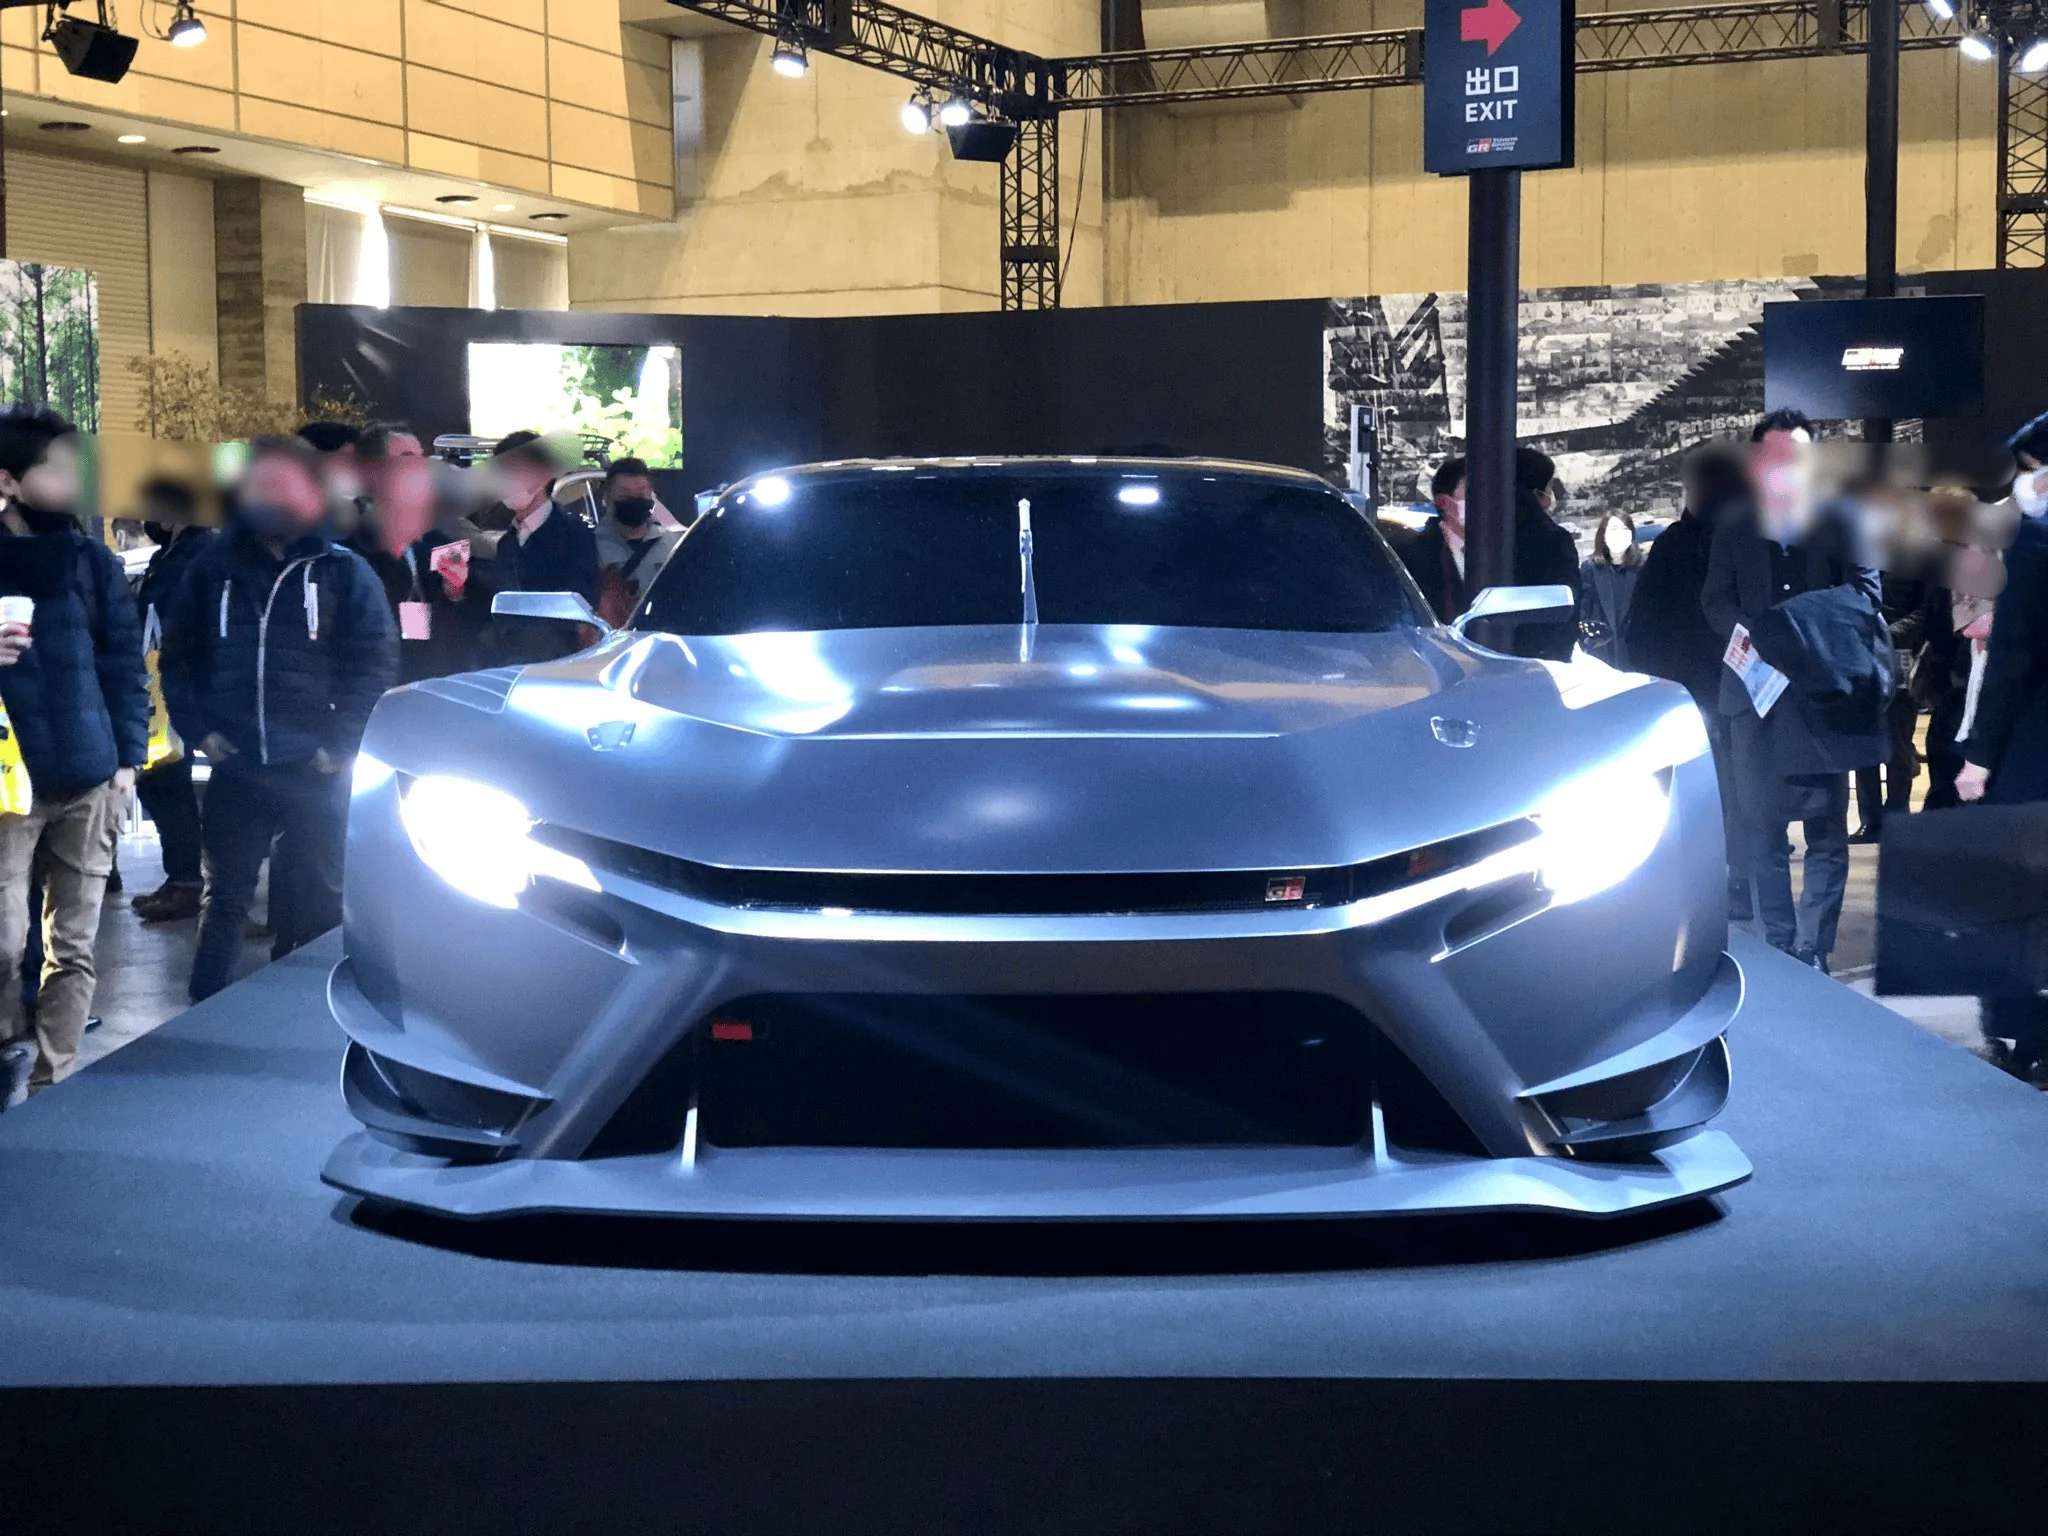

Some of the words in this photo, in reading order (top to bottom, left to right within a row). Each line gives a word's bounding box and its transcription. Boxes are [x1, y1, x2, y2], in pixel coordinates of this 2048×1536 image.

[1465, 66, 1519, 96] 出口
[1465, 100, 1518, 122] EXIT
[1466, 142, 1491, 153] GR
[1267, 883, 1304, 900] GR
